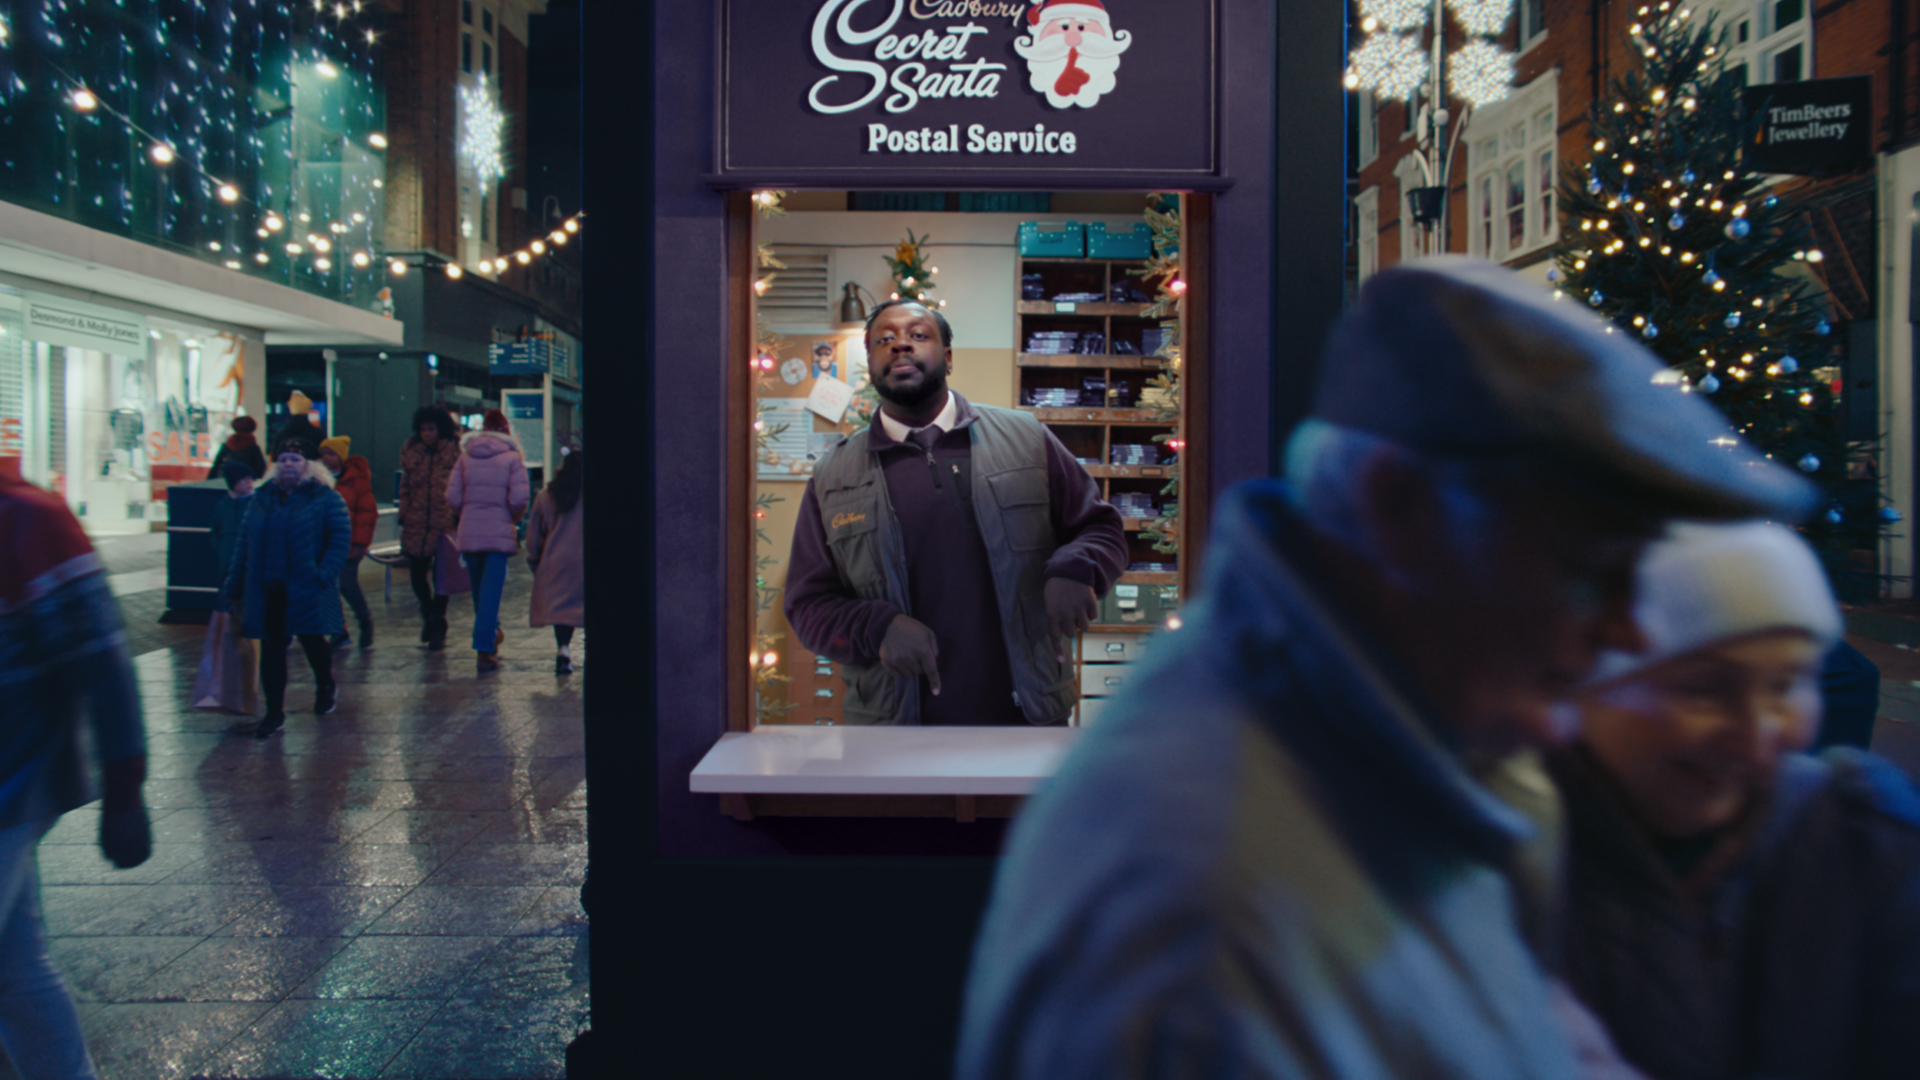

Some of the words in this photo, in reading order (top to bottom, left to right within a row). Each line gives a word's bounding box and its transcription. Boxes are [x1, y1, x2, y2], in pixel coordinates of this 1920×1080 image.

[909, 0, 1025, 27] Cadbury
[808, 0, 988, 114] Secret
[885, 57, 1007, 113] Santa
[1769, 103, 1851, 124] TimBeers
[868, 123, 959, 152] Postal
[966, 123, 1077, 153] Service
[1768, 122, 1849, 144] Jewellery
[30, 308, 76, 327] Desmond
[77, 319, 85, 329] &
[87, 320, 113, 335] Molly
[147, 431, 213, 463] SALE
